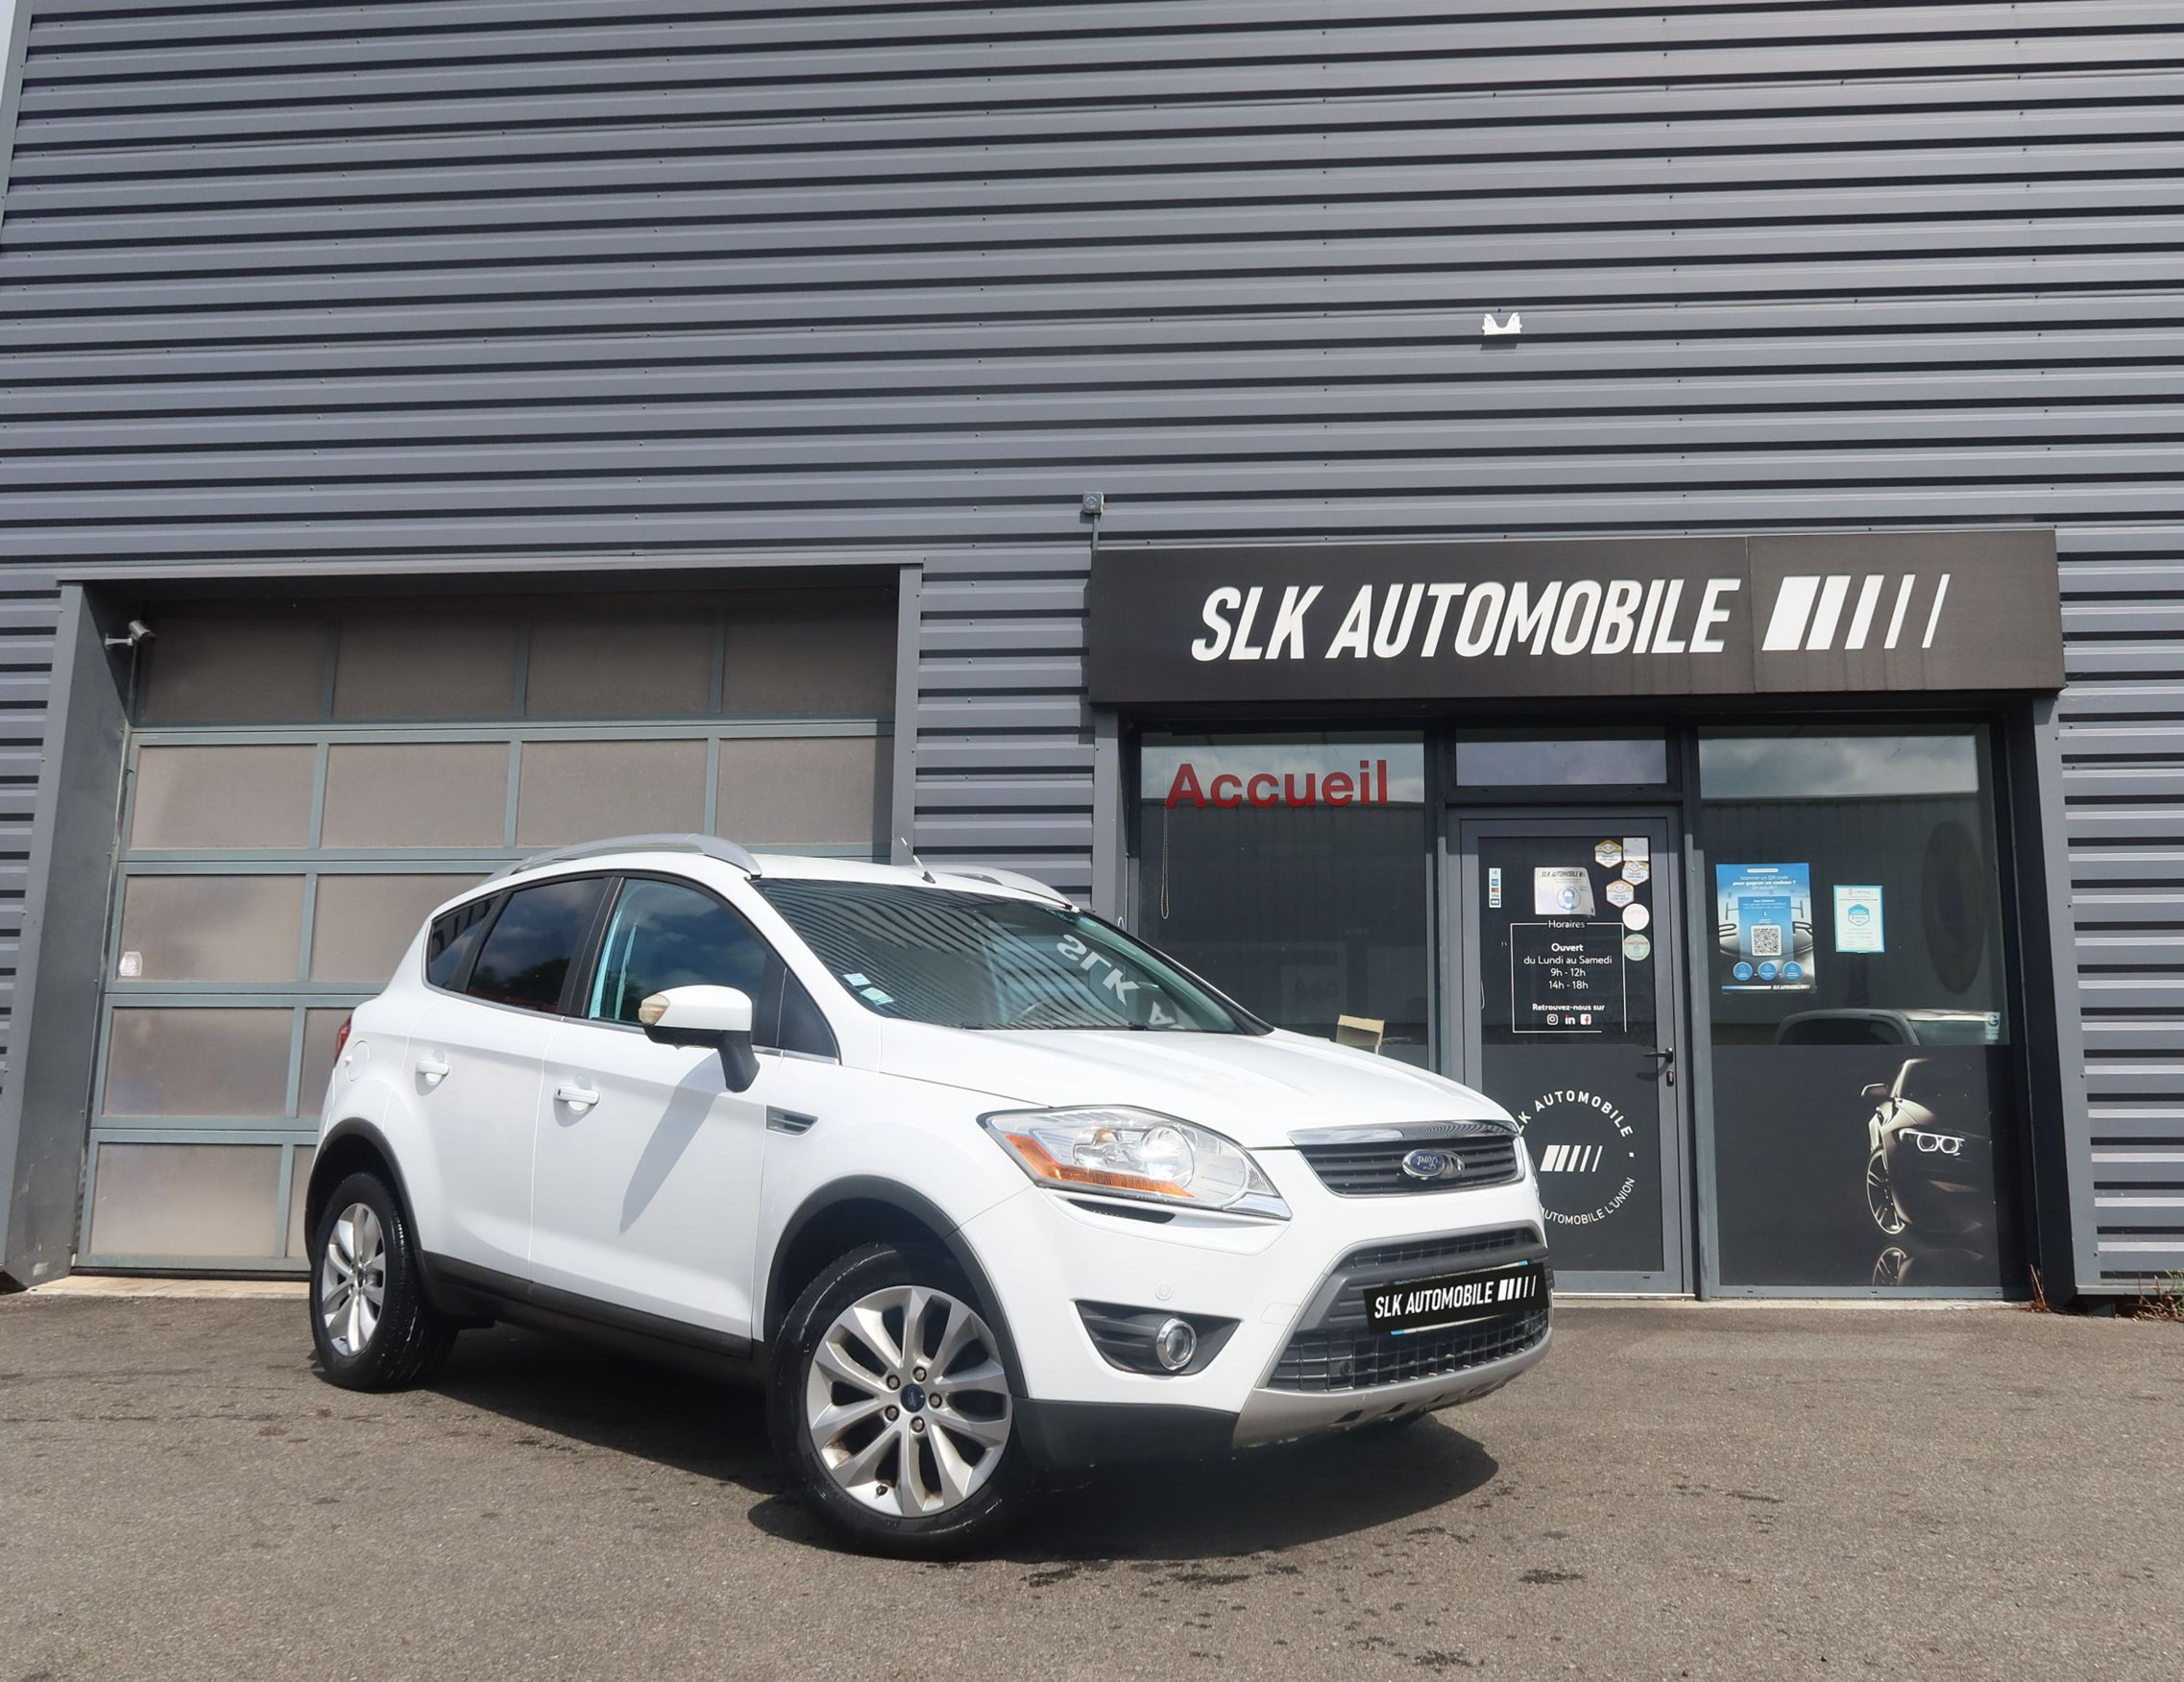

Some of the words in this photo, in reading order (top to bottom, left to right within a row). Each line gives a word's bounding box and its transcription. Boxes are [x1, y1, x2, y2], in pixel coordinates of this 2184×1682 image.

[1192, 584, 1324, 662] SLK
[1325, 579, 1741, 659] AUTOMOBILE
[1166, 759, 1388, 809] Accueil
[1548, 920, 1586, 929] Horaires
[1551, 943, 1583, 951] Ouvert
[1524, 956, 1535, 964] du
[1538, 956, 1564, 964] Lundi
[1579, 955, 1613, 964] Samedi
[1550, 967, 1563, 977] 9h
[1570, 967, 1586, 977] 12h
[1548, 980, 1564, 989] 14h
[1572, 980, 1588, 989] 18h
[1535, 1090, 1634, 1138] AUTOMOBILE
[1604, 1177, 1635, 1214] L'UNION
[1374, 1293, 1403, 1319] SLK
[1404, 1274, 1495, 1314] AUTOMOBILE
